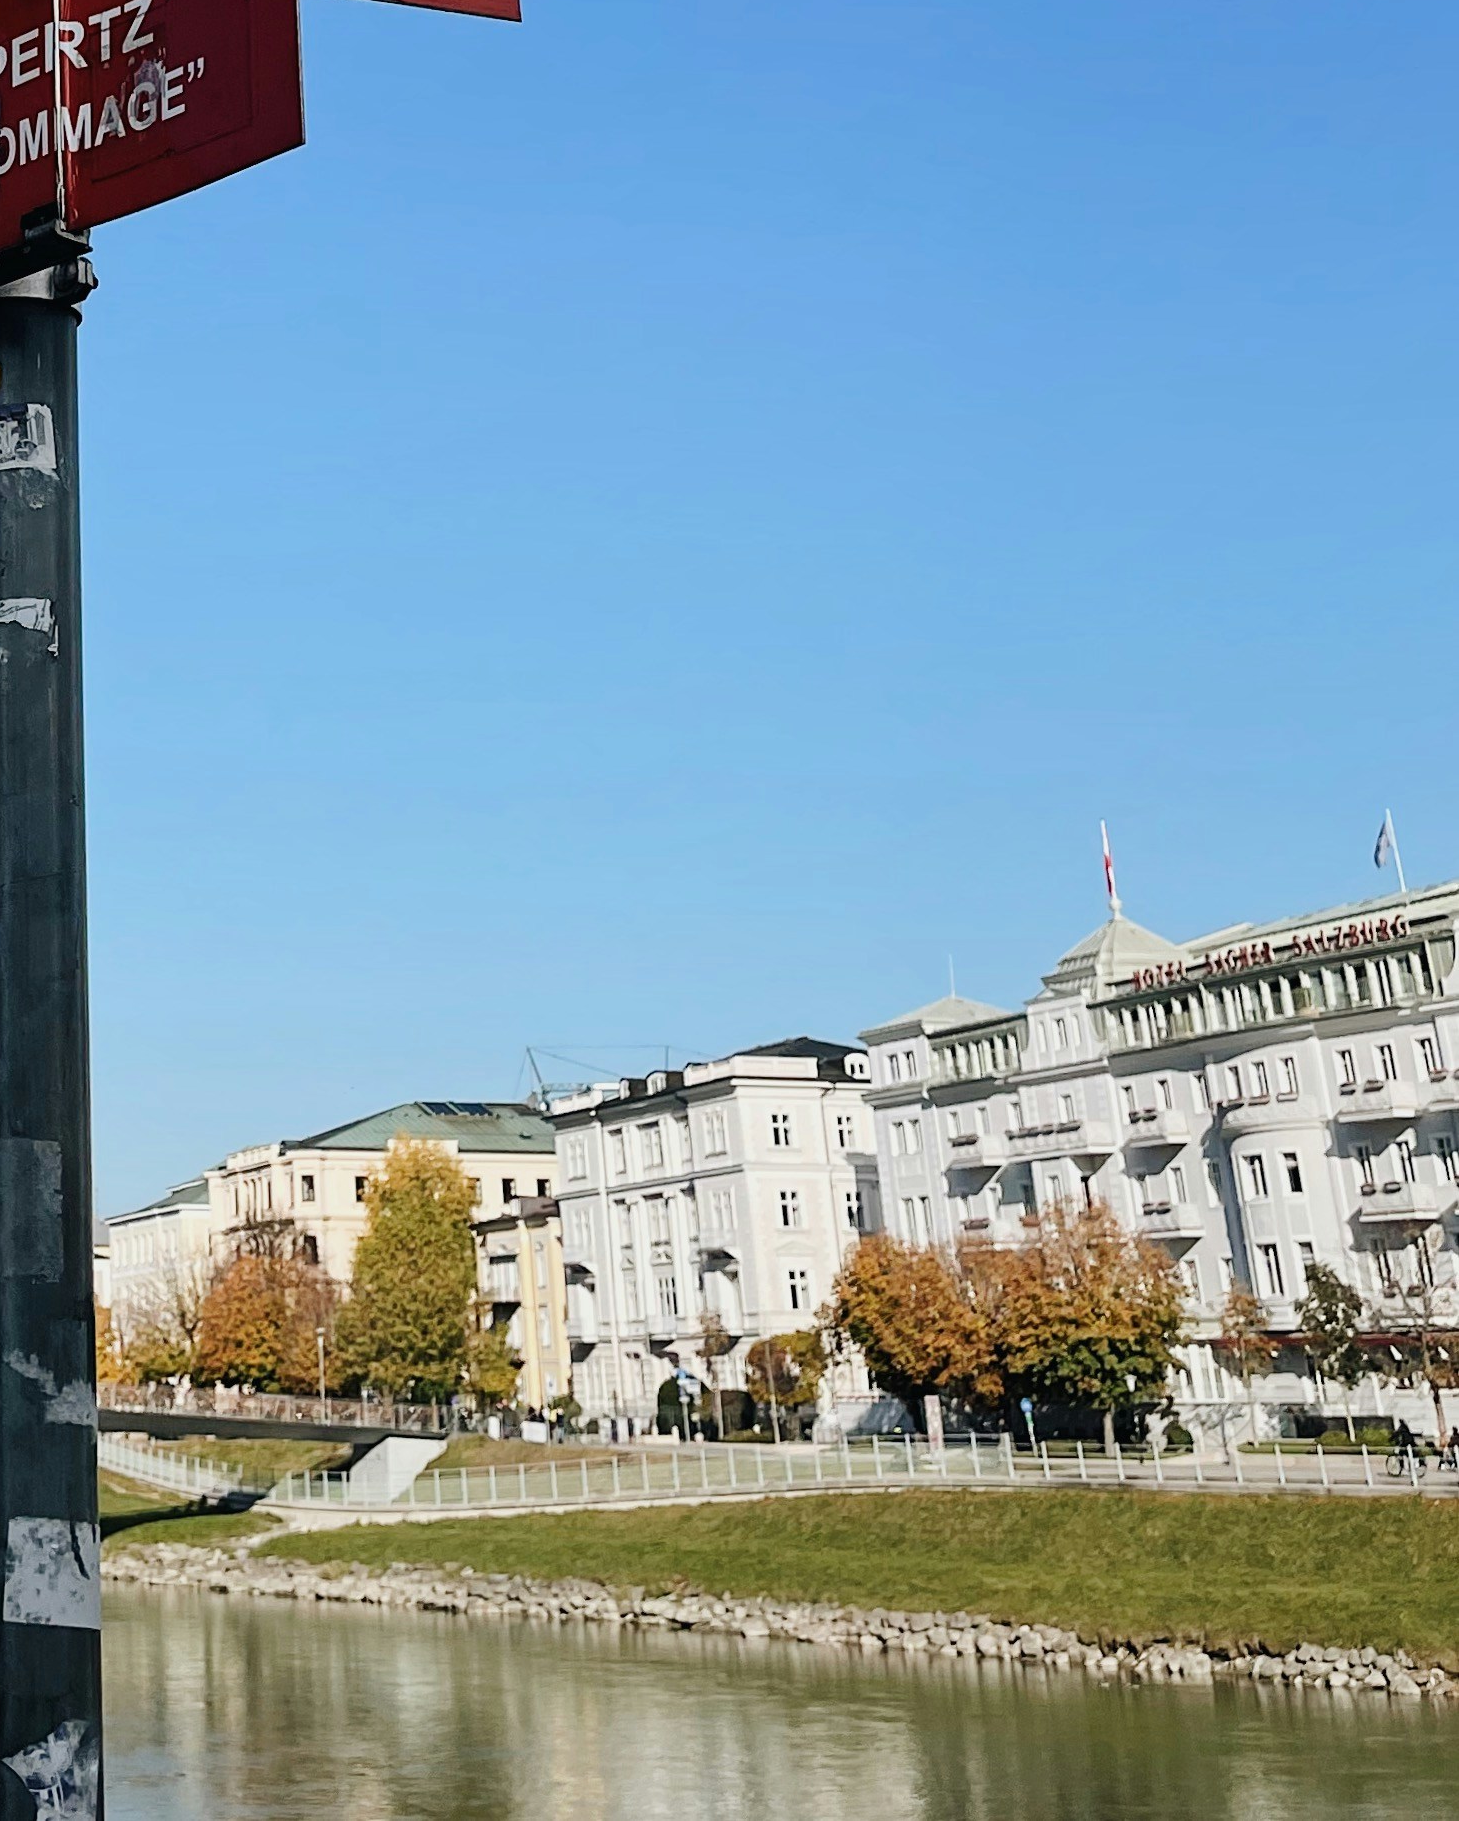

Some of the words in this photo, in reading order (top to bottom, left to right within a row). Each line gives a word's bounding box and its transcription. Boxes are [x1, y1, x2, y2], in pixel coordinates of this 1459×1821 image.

[1130, 960, 1187, 991] HOTEL
[1204, 941, 1276, 975] SACHER
[1292, 914, 1411, 956] SALZBURG
